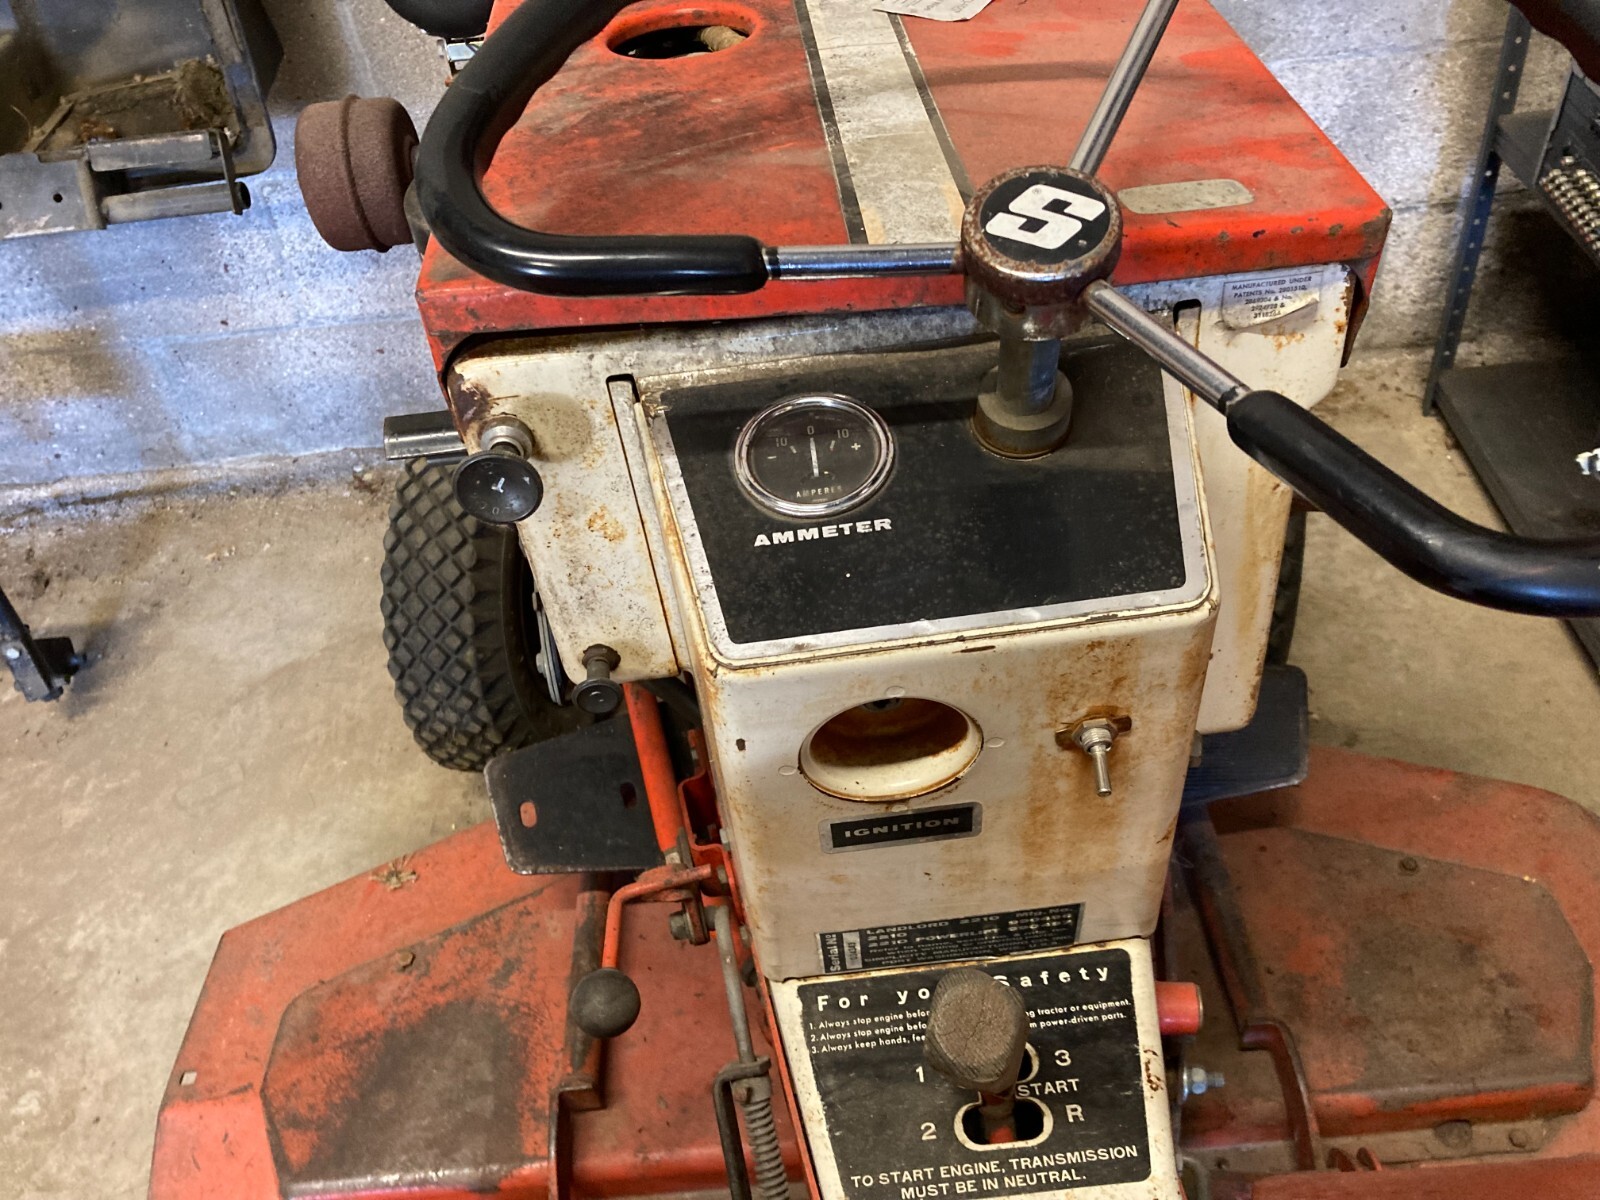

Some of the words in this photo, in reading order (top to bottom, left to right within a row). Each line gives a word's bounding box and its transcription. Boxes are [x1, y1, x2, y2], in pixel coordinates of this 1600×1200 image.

[1232, 279, 1286, 290] MANUFACTURED
[1289, 276, 1312, 284] UNDER
[1233, 290, 1262, 298] PATENTS
[807, 425, 815, 435] 0
[837, 428, 849, 439] 10
[796, 485, 842, 498] AMPERES
[753, 518, 893, 547] AMMETER
[844, 816, 960, 838] IGNITION
[866, 921, 949, 935] LANDLORD
[915, 929, 998, 941] POWERLIFT
[827, 945, 841, 972] Serial
[817, 994, 869, 1012] For
[809, 1022, 817, 1030] 1.
[818, 1020, 850, 1030] Always
[853, 1017, 872, 1026] stop
[874, 1012, 904, 1023] engine
[906, 1009, 930, 1019] befor
[810, 1034, 819, 1042] 2.
[820, 1031, 851, 1041] Always
[853, 1028, 872, 1038] stop
[874, 1024, 904, 1036] engine
[906, 1021, 928, 1031] befo
[1037, 1007, 1068, 1016] tractor
[1082, 999, 1132, 1011] equipment.
[811, 1046, 819, 1054] 3.
[821, 1043, 852, 1053] Always
[855, 1040, 877, 1050] keep
[879, 1035, 910, 1046] hands,
[912, 1033, 926, 1042] fee
[1040, 1015, 1099, 1029] power-driven
[1101, 1011, 1127, 1022] parts.
[1054, 1049, 1072, 1067] 3
[915, 1065, 925, 1083] 1
[1017, 1078, 1079, 1097] START
[1065, 1103, 1085, 1123] R
[920, 1122, 937, 1141] 2
[850, 1175, 874, 1188] TO
[879, 1167, 934, 1185] START
[940, 1160, 1006, 1179] ENGINE,
[1009, 1145, 1138, 1170] TRANSMISSION
[901, 1183, 950, 1200] MUST
[955, 1179, 978, 1194] BE
[982, 1177, 999, 1191] IN
[1004, 1168, 1086, 1188] NEUTRAL.
